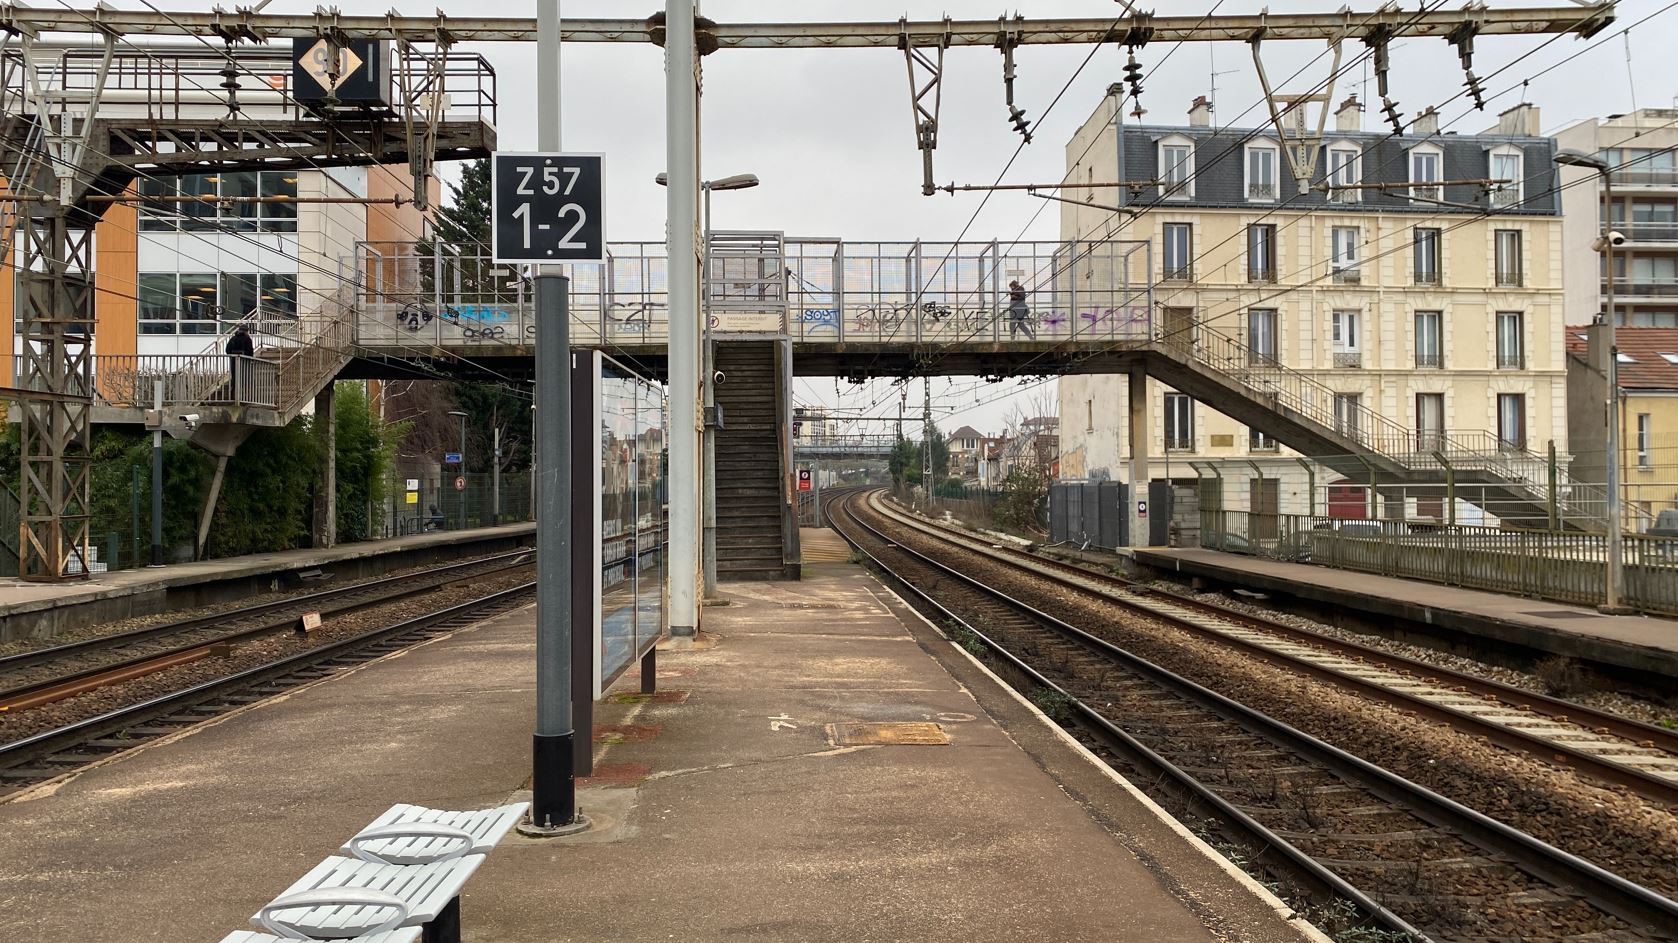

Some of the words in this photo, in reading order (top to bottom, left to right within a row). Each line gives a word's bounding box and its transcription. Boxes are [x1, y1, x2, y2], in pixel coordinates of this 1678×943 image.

[516, 166, 535, 195] Z
[542, 166, 581, 196] 57
[511, 202, 587, 249] 1-2
